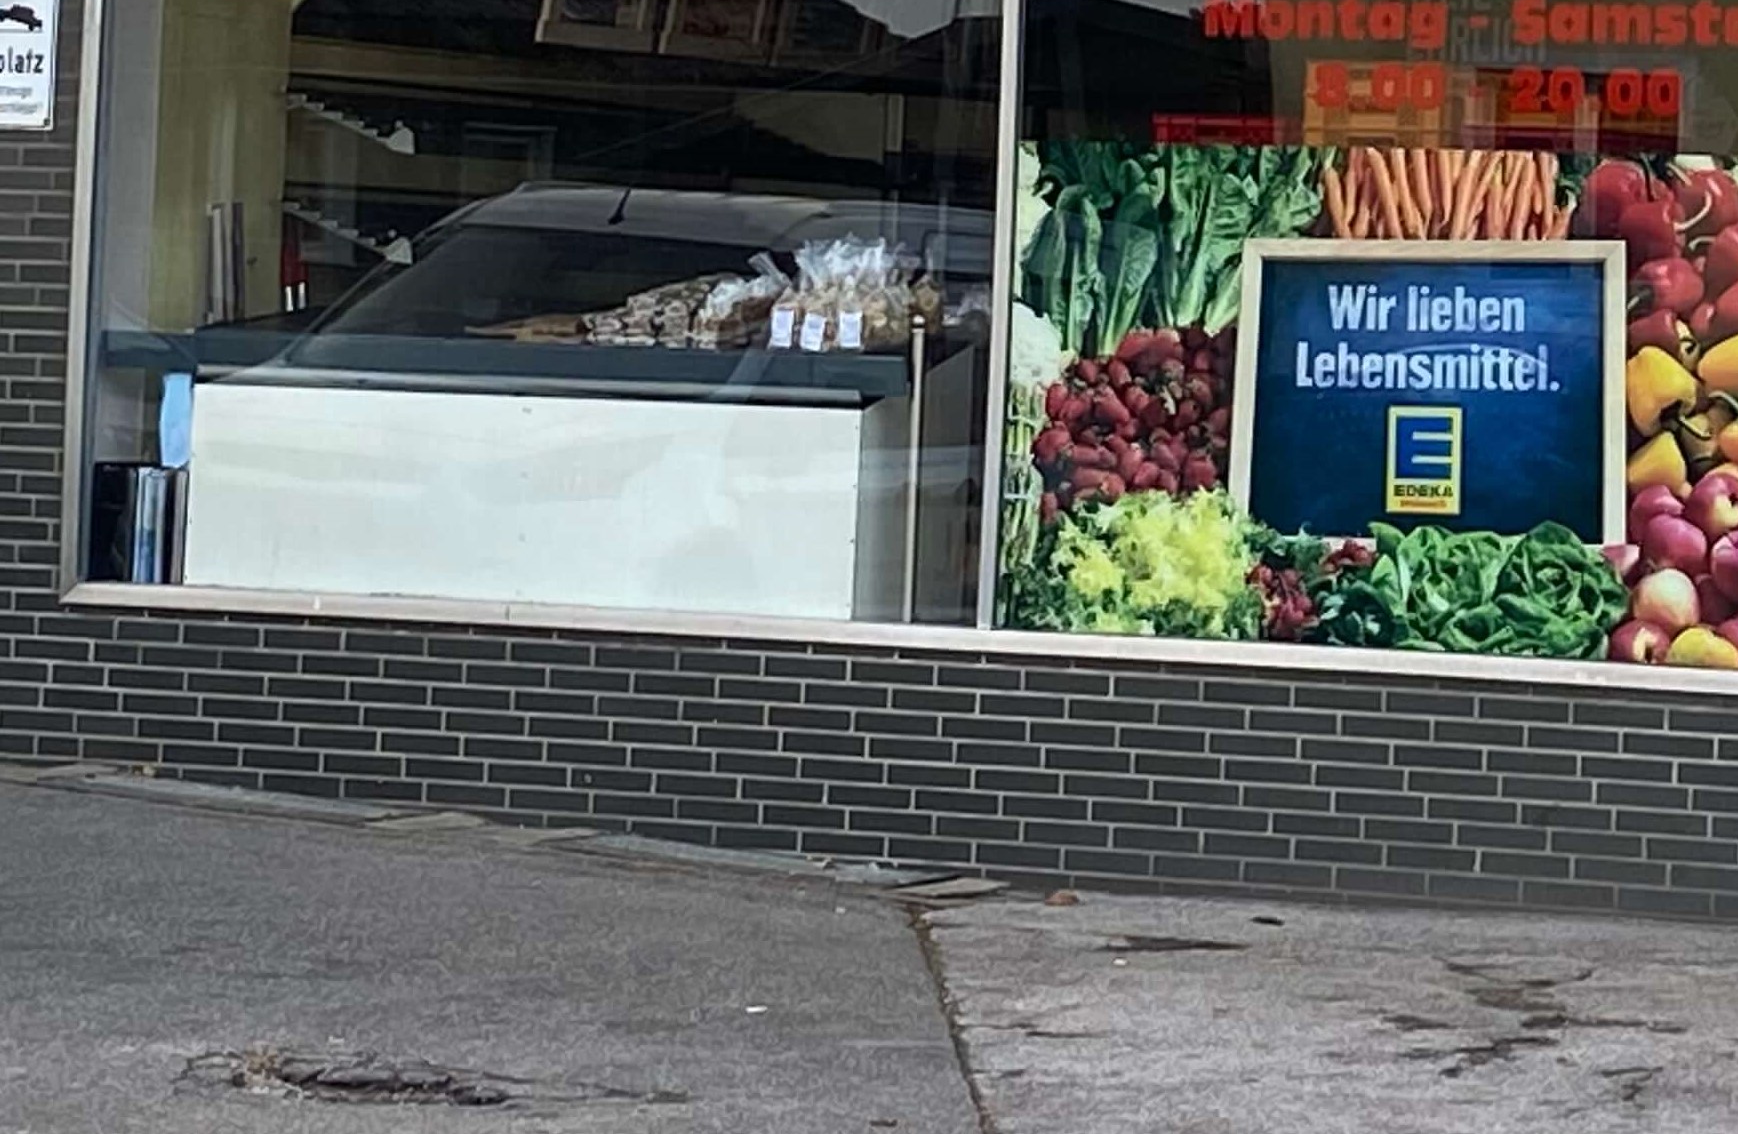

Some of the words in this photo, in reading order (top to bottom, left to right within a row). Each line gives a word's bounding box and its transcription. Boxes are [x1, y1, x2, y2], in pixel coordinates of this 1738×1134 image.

[1328, 284, 1397, 332] Wir
[1407, 285, 1525, 332] lieben
[1295, 341, 1560, 392] Lebensmittel.
[1393, 484, 1454, 497] EDEKA
